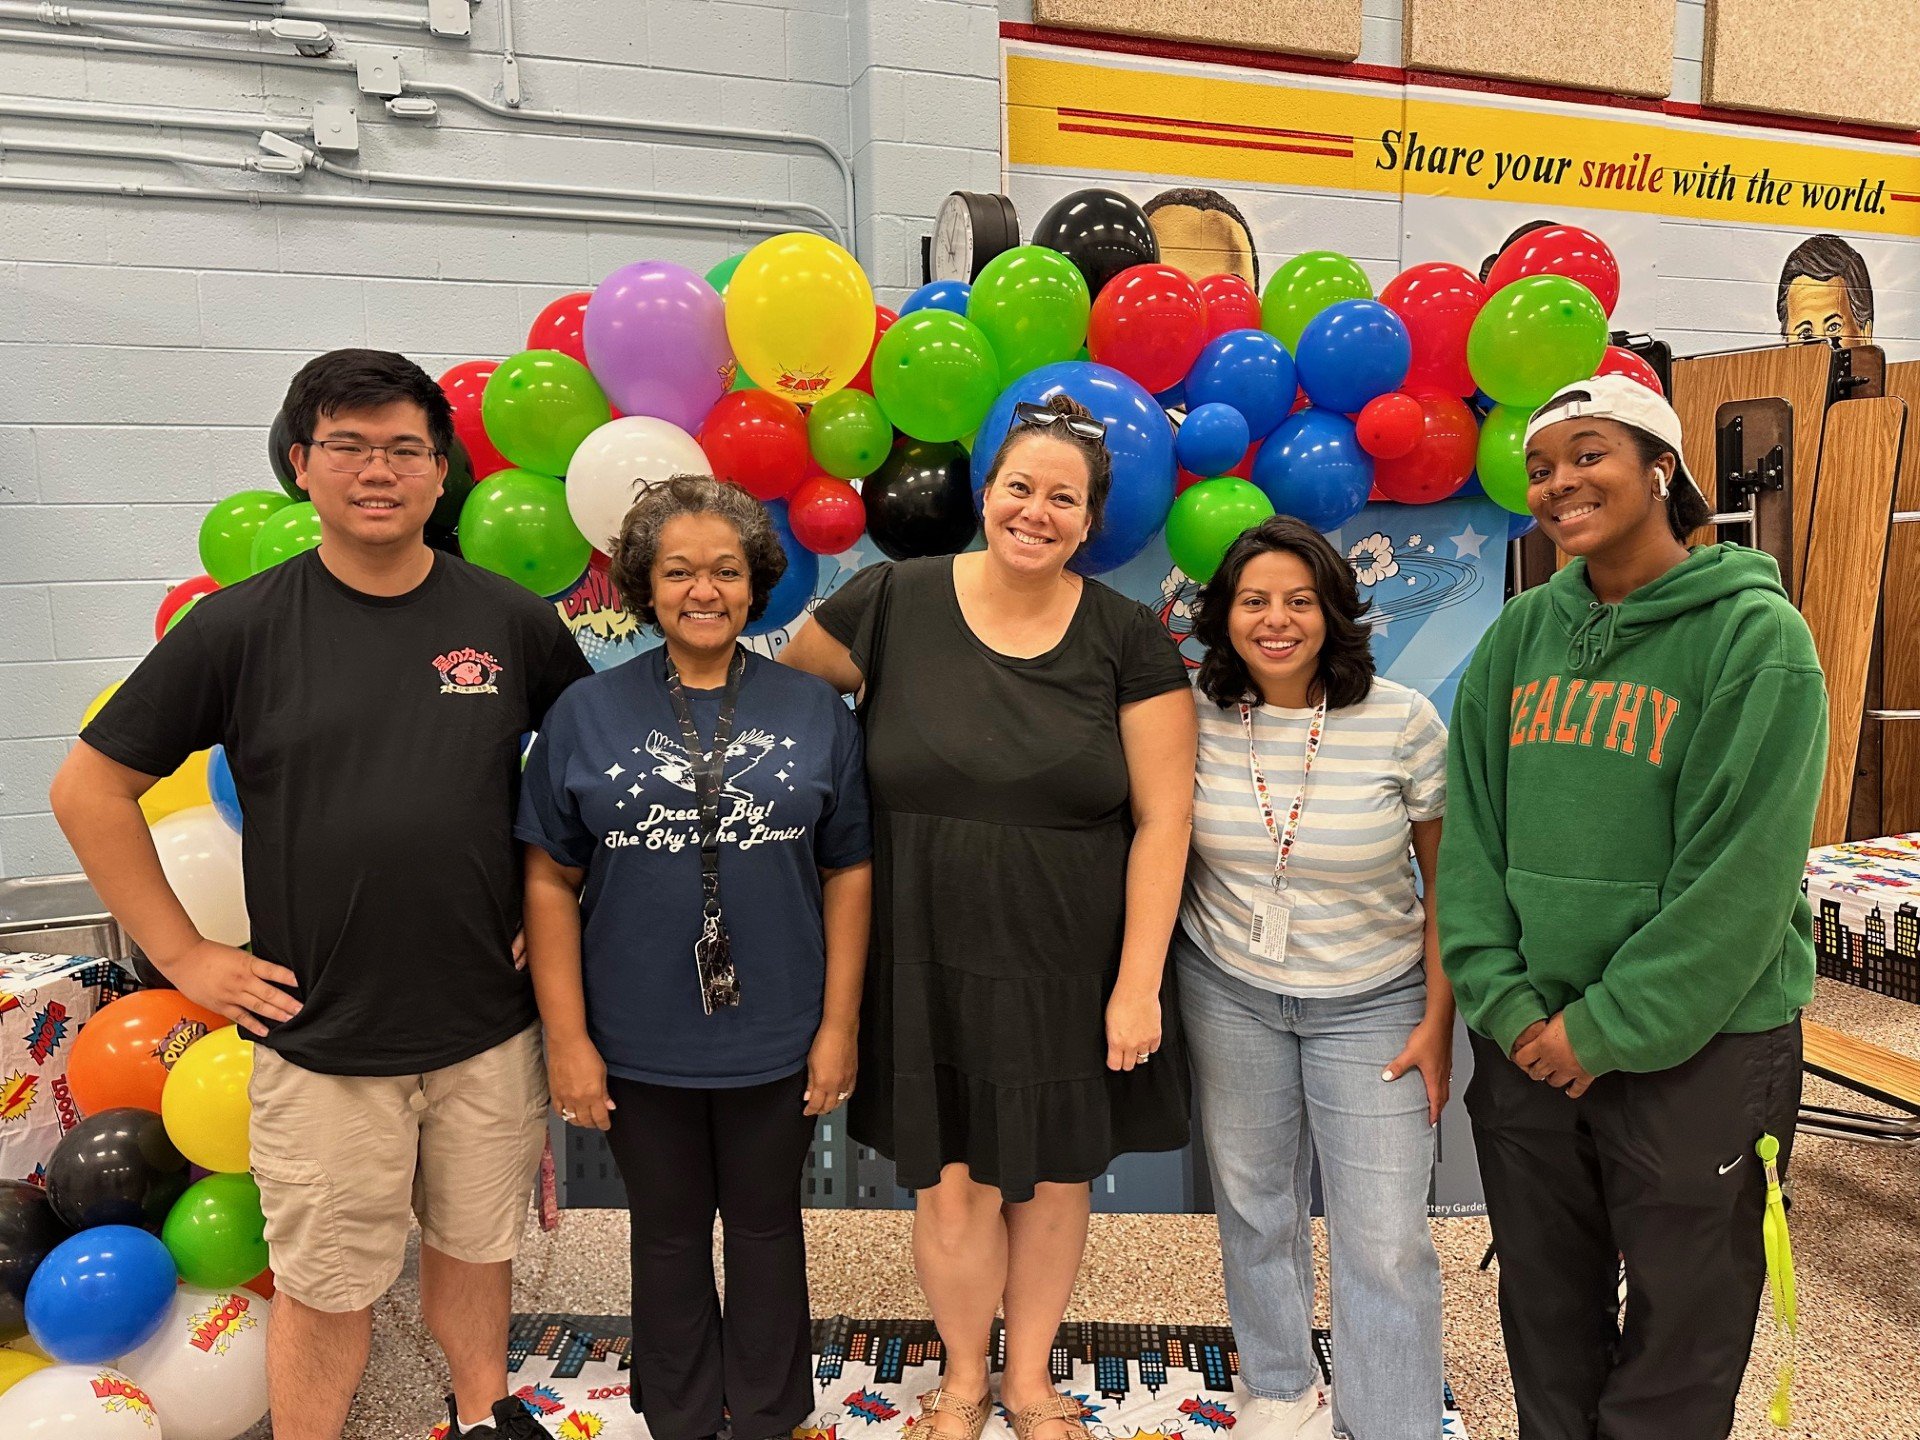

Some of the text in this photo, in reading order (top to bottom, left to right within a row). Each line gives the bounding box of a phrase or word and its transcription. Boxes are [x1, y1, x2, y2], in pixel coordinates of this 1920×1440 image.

[1376, 130, 1886, 215] Share your smile with the world.
[776, 373, 832, 391] ZAP!
[636, 800, 776, 832] Drea Big!
[604, 823, 806, 853] The Sky's he Limit!
[51, 1074, 78, 1130] ZOOO
[1426, 1204, 1451, 1215] ttery
